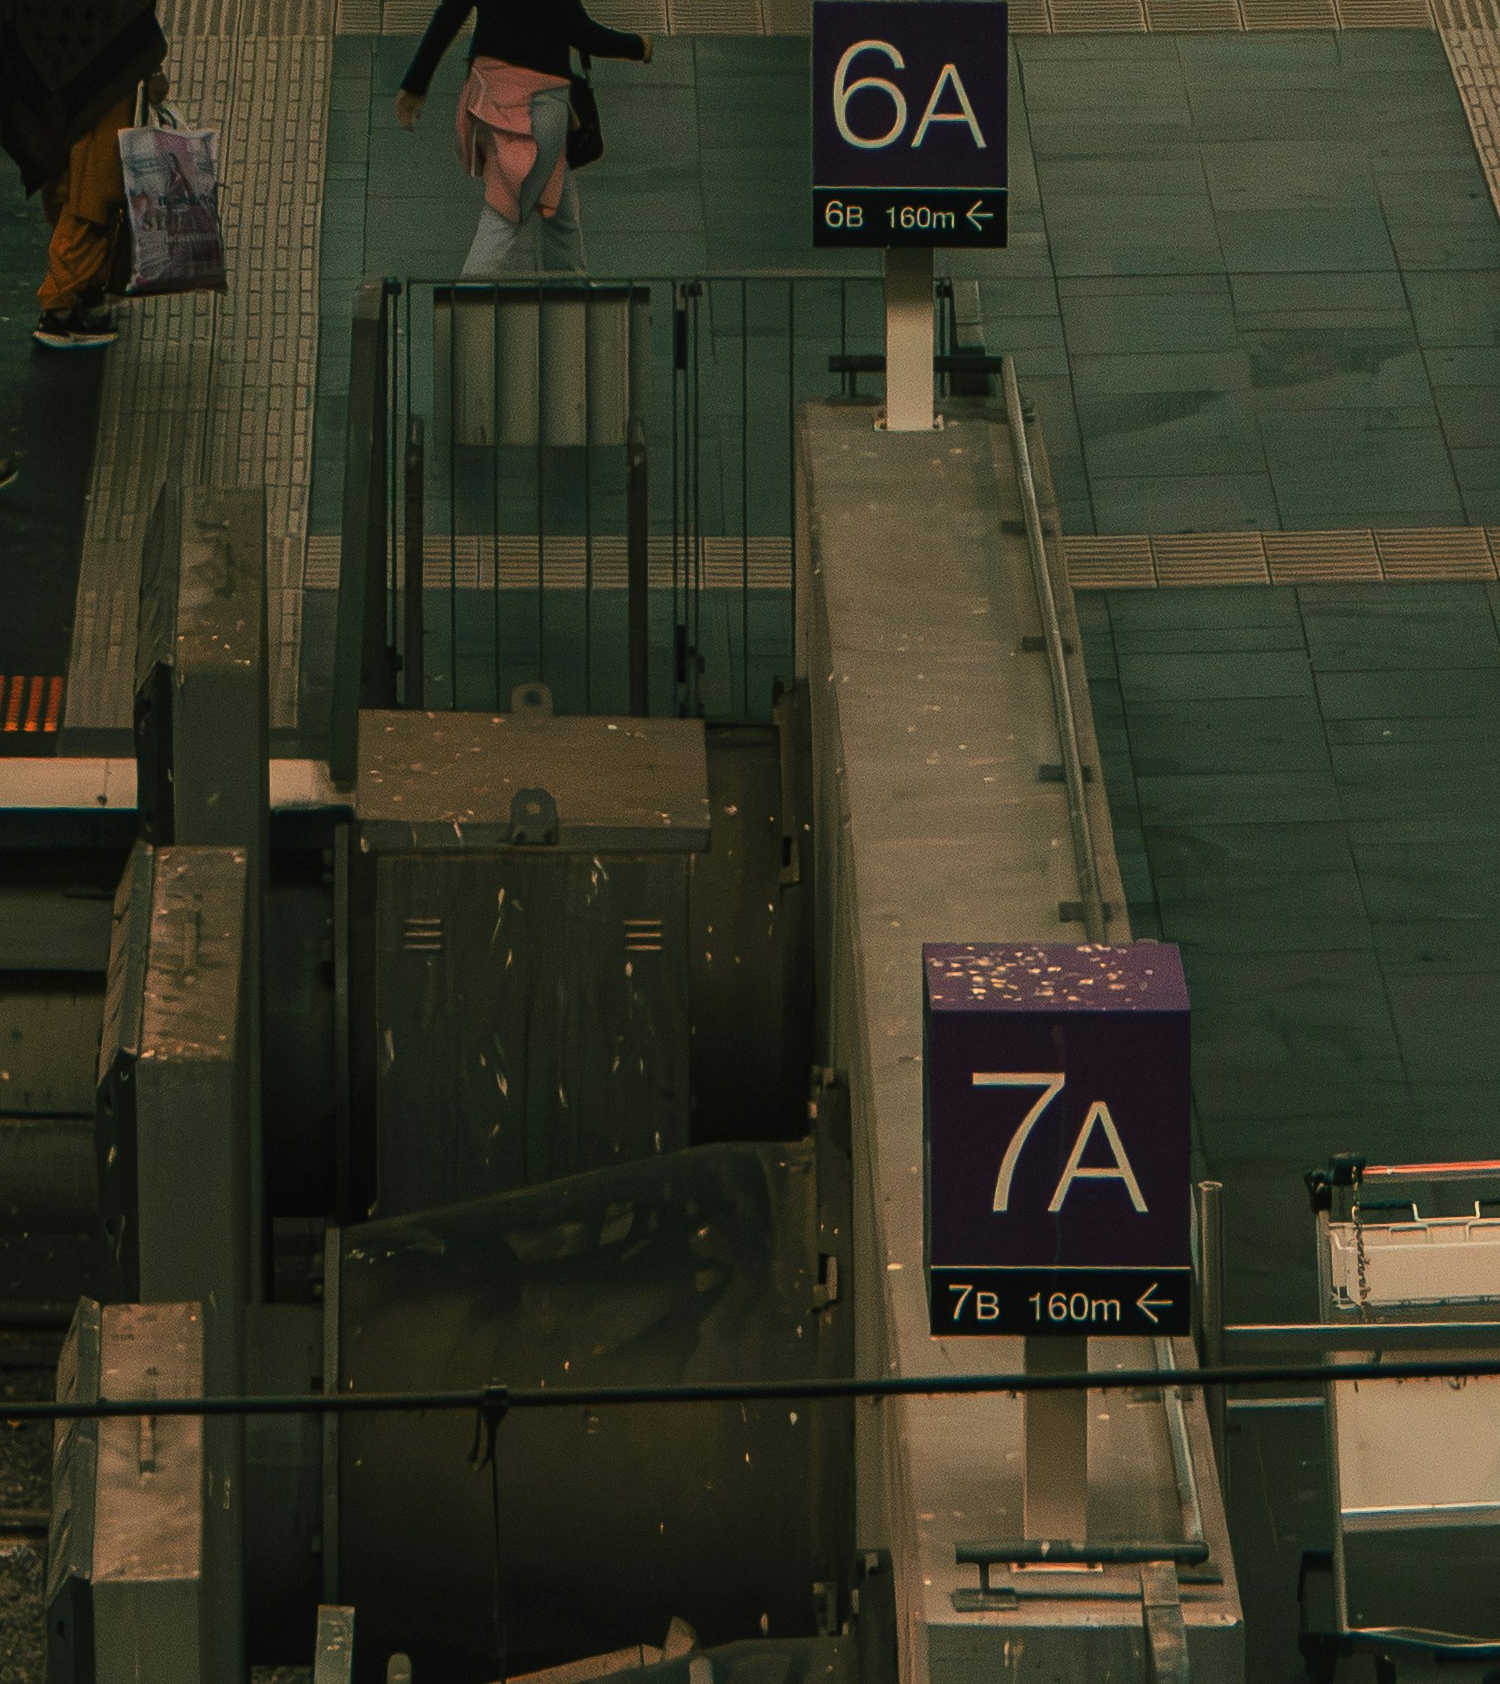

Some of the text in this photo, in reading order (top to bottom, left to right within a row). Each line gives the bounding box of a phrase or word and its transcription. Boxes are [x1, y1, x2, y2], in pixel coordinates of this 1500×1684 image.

[832, 38, 988, 150] 6A
[825, 200, 956, 229] 6B 160m
[971, 1071, 1150, 1213] 7A
[948, 1283, 1122, 1322] 7B 160m
